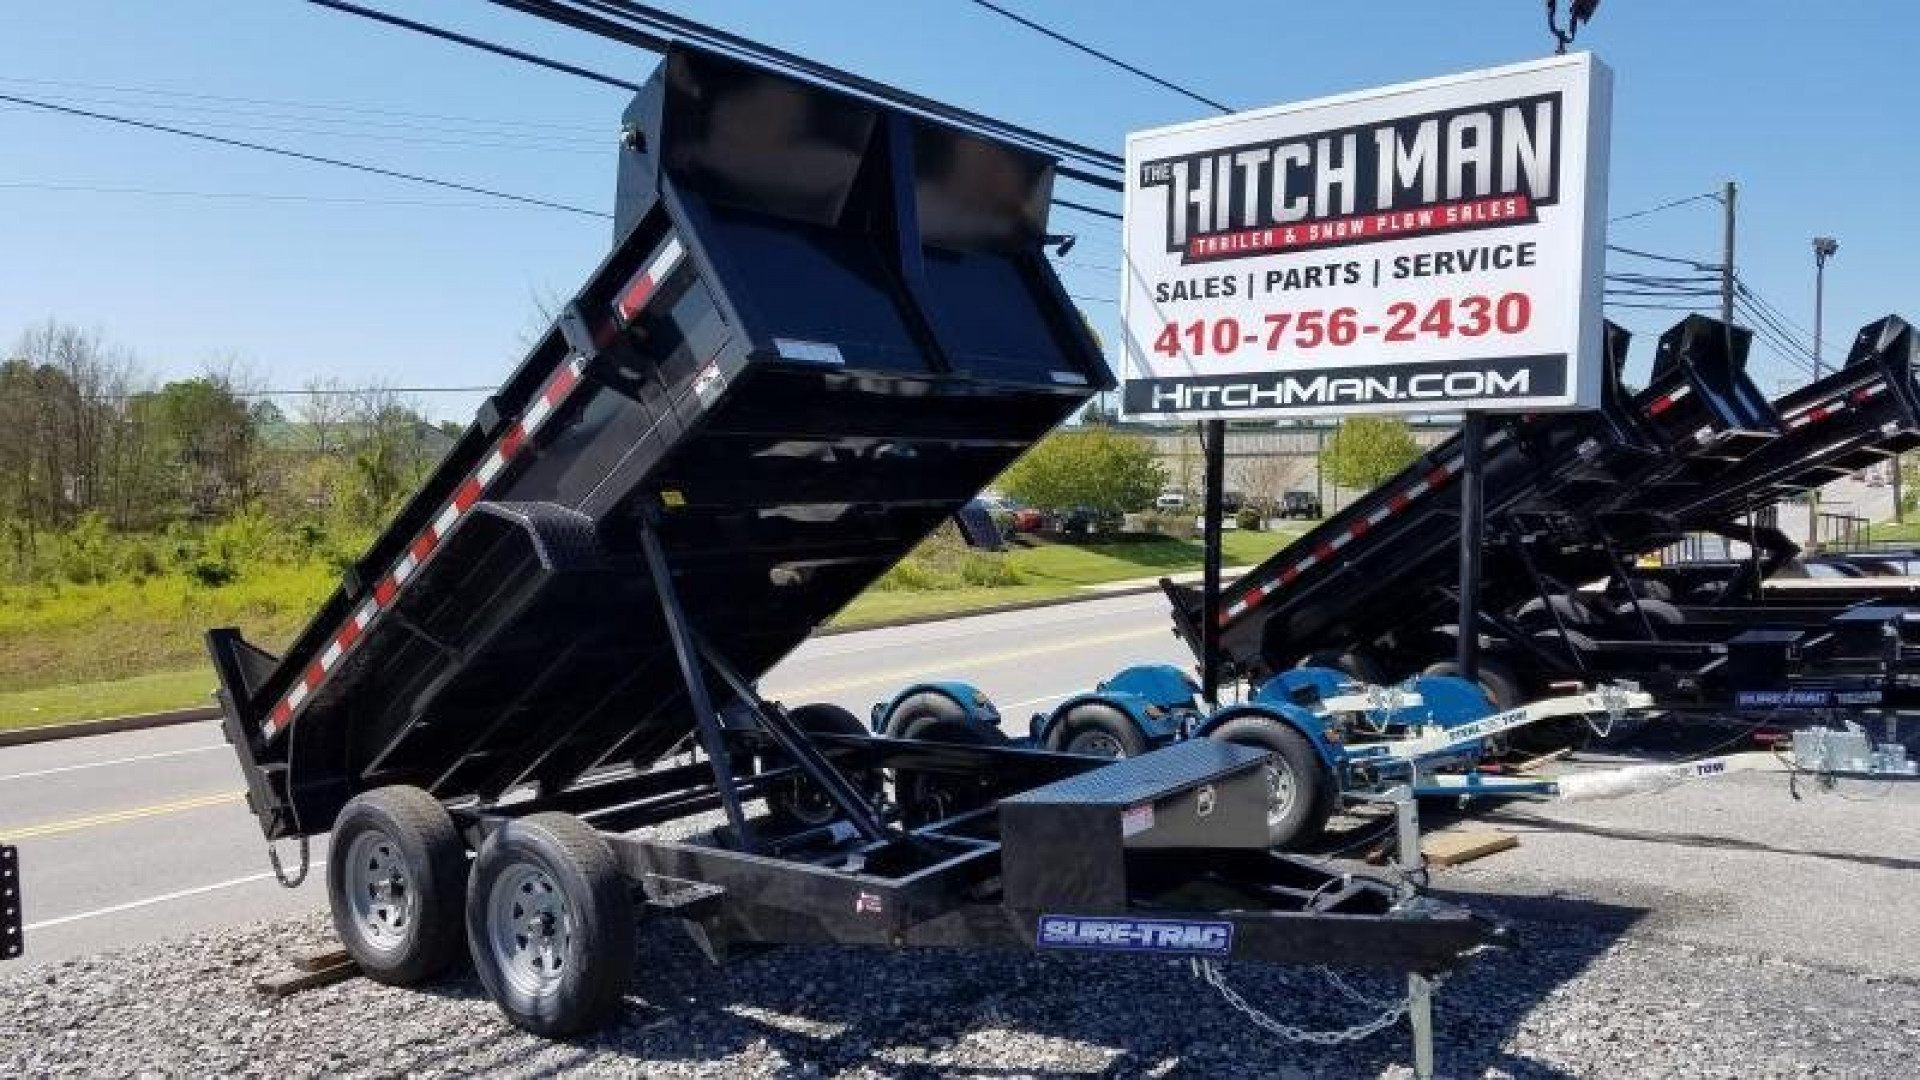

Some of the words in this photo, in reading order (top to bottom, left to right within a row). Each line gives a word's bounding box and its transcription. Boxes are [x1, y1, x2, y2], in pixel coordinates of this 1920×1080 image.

[1143, 163, 1172, 183] THE
[1173, 133, 1357, 246] HITCH
[1374, 100, 1554, 210] MAN
[1197, 229, 1273, 253] TRAILER
[1286, 227, 1297, 243] &
[1309, 219, 1364, 240] SNOW
[1377, 209, 1434, 231] PLOW
[1446, 199, 1516, 223] SALES
[1156, 274, 1238, 303] SALES
[1266, 260, 1362, 293] PARTS
[1393, 241, 1537, 279] SERVICE
[1154, 291, 1531, 358] 410-756-2430
[1043, 920, 1228, 949] SURE-TRAC
